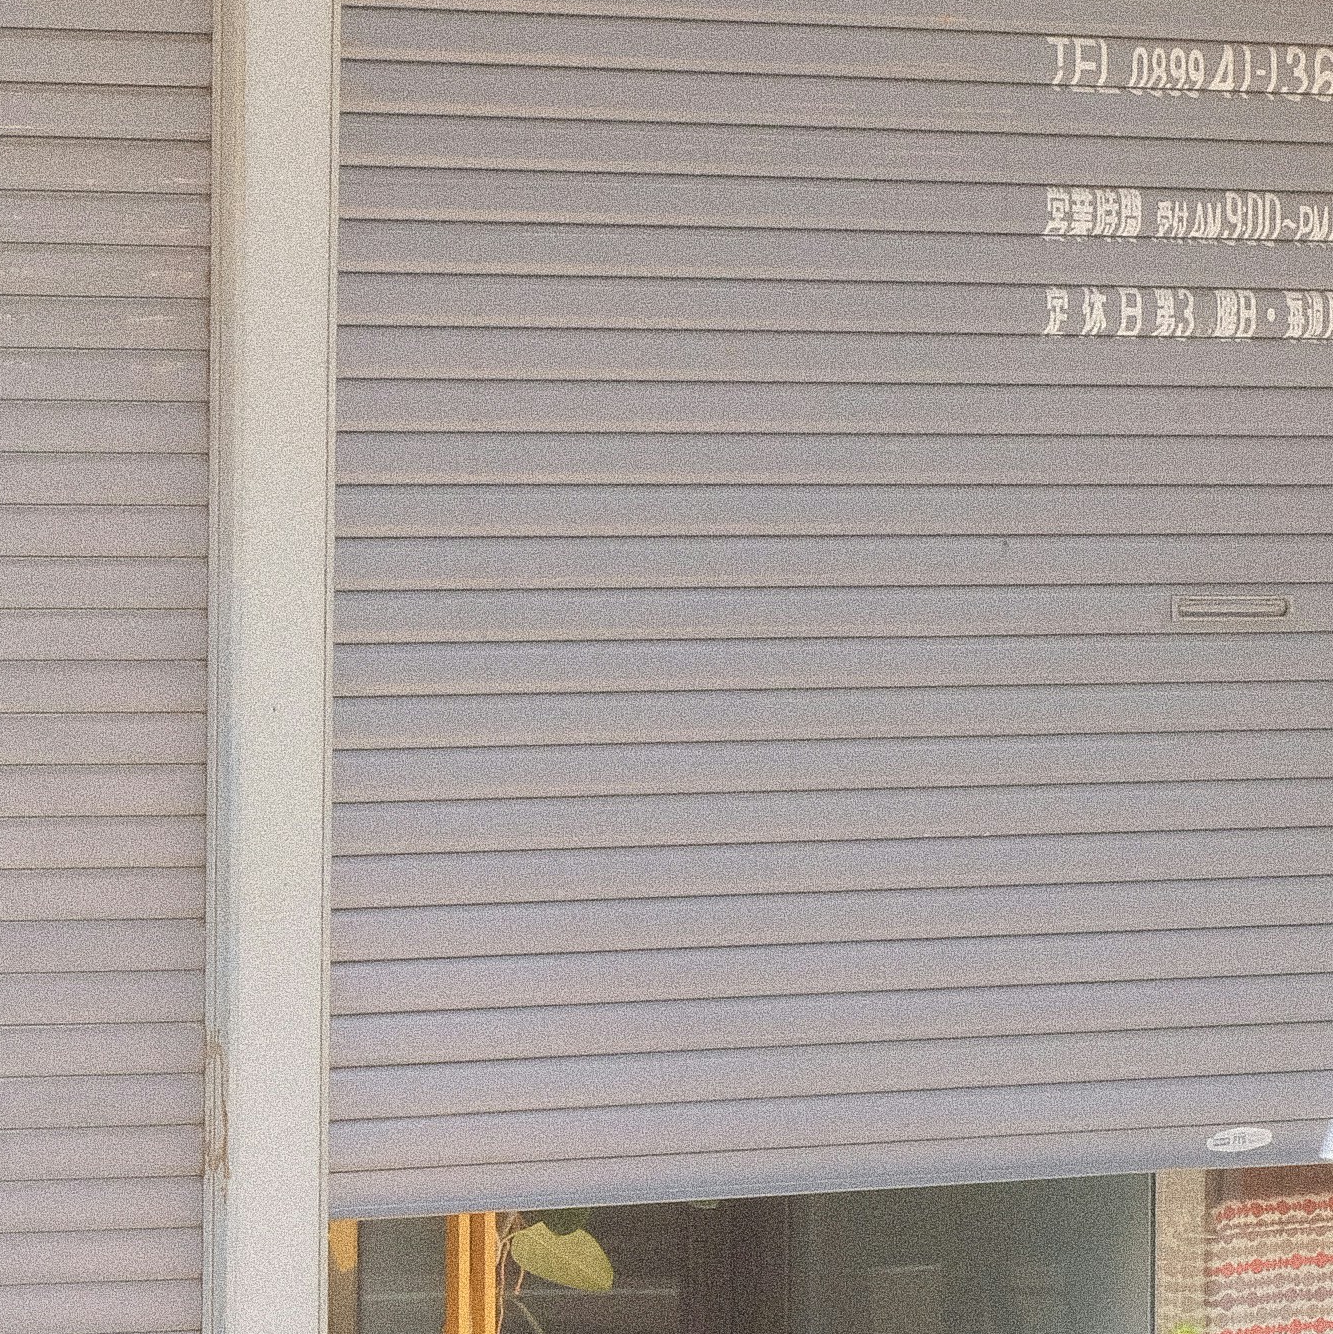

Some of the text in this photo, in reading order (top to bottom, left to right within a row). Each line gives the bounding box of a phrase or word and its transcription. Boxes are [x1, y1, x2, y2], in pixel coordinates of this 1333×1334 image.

[1046, 37, 1120, 95] TEL
[1128, 46, 1204, 98] 0899
[1042, 188, 1142, 242] 営業時間
